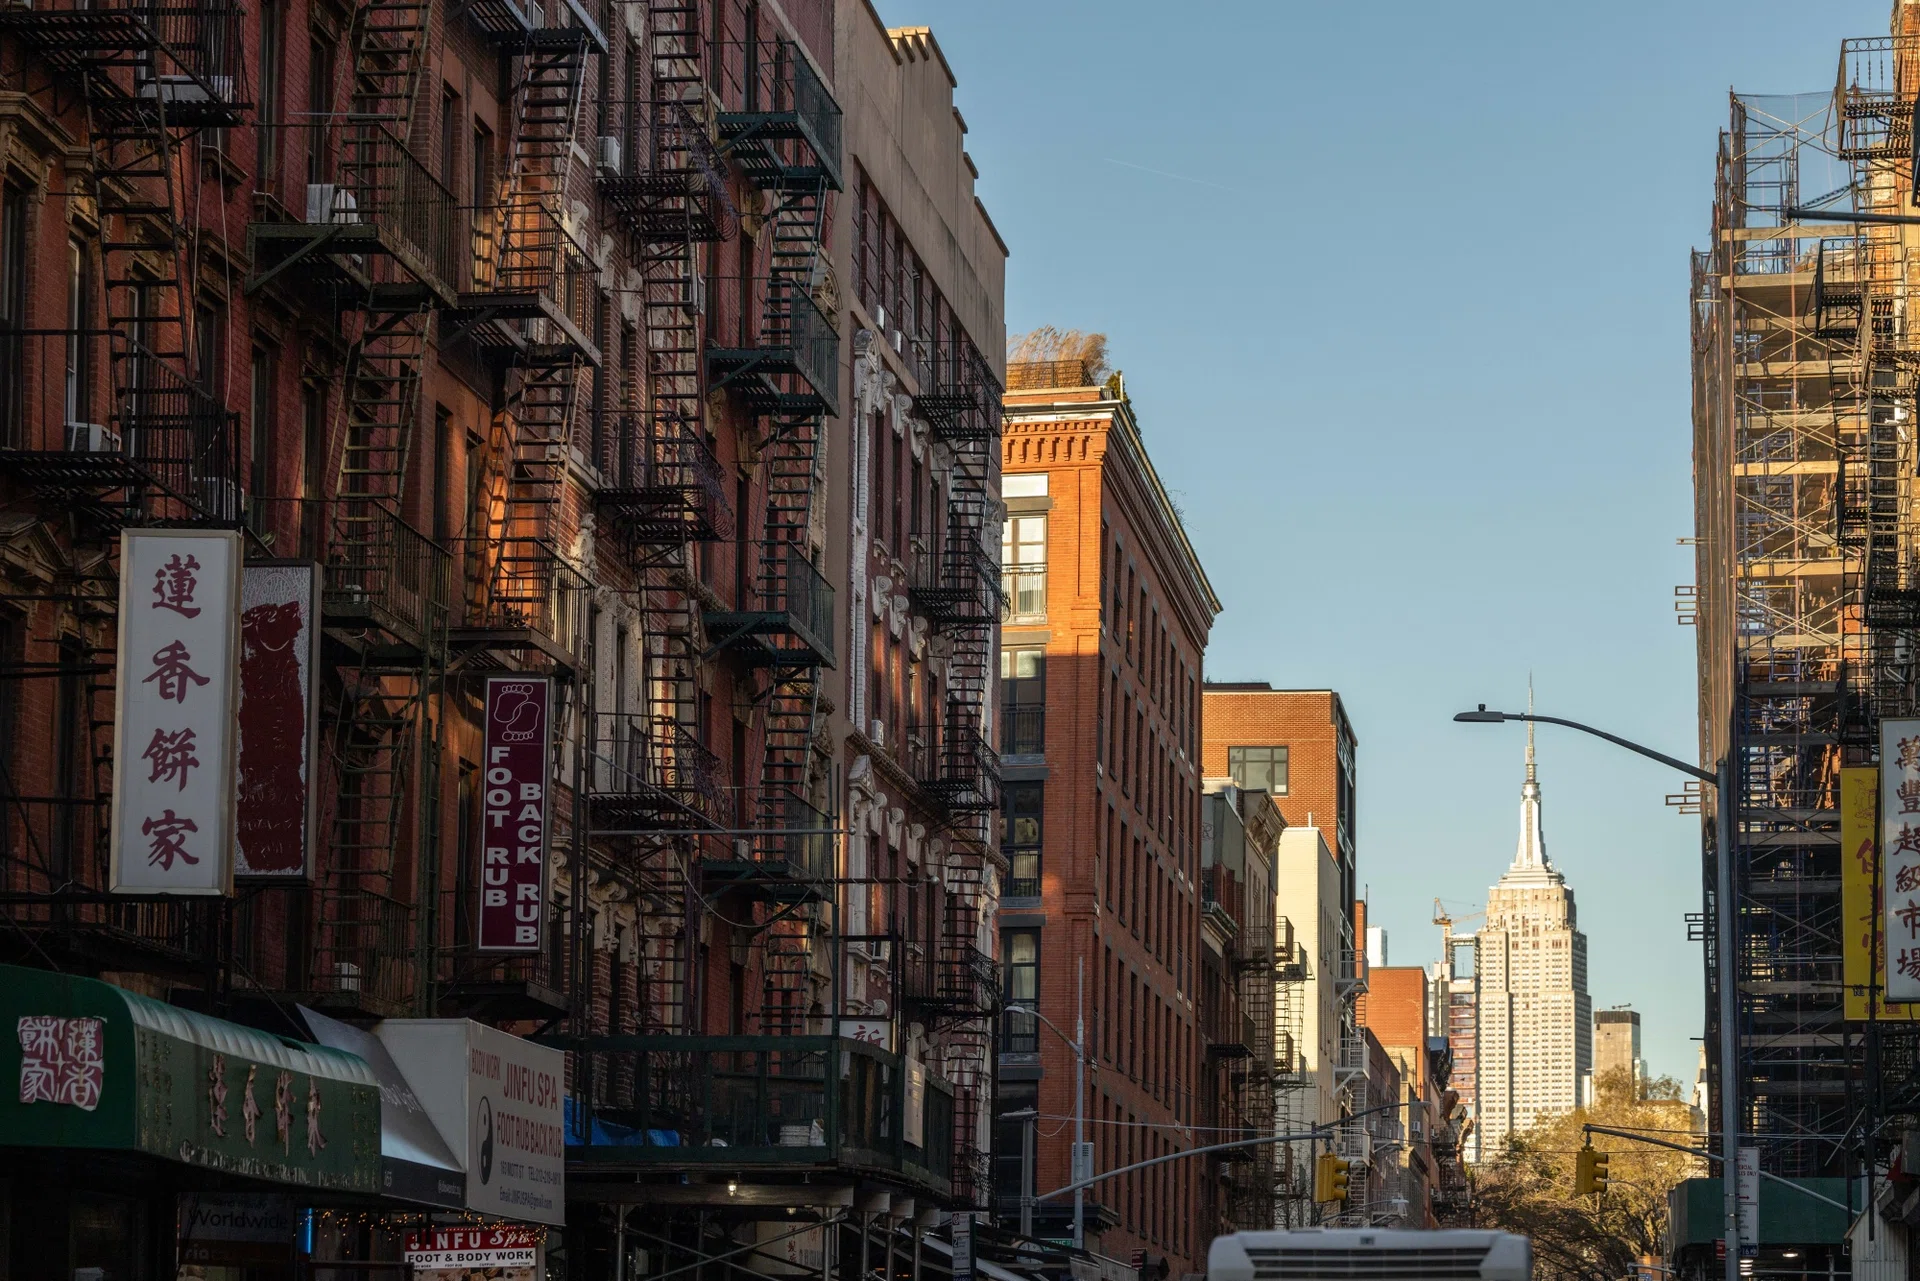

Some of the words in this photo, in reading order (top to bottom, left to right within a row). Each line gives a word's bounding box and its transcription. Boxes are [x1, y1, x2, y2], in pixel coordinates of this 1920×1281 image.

[141, 553, 211, 872] 蓮香餅家
[486, 746, 512, 828] FOOT
[517, 783, 543, 864] BACK
[485, 847, 510, 907] RUB
[515, 884, 540, 943] RUB
[472, 1048, 485, 1076] BODY
[486, 1053, 500, 1080] WORK
[503, 1062, 535, 1104] JINFU
[537, 1071, 558, 1110] SPA
[496, 1111, 515, 1147] FOOT
[516, 1116, 530, 1151] RUB
[530, 1121, 548, 1156] BACK
[548, 1125, 562, 1159] RUB
[507, 1162, 518, 1178] MOTT
[519, 1164, 524, 1179] ST
[189, 1209, 288, 1229] Worldwide
[409, 1232, 481, 1250] JNFU
[408, 1254, 441, 1263] FOOT
[445, 1254, 453, 1262] &
[457, 1252, 491, 1261] BODY
[496, 1251, 533, 1260] WORK
